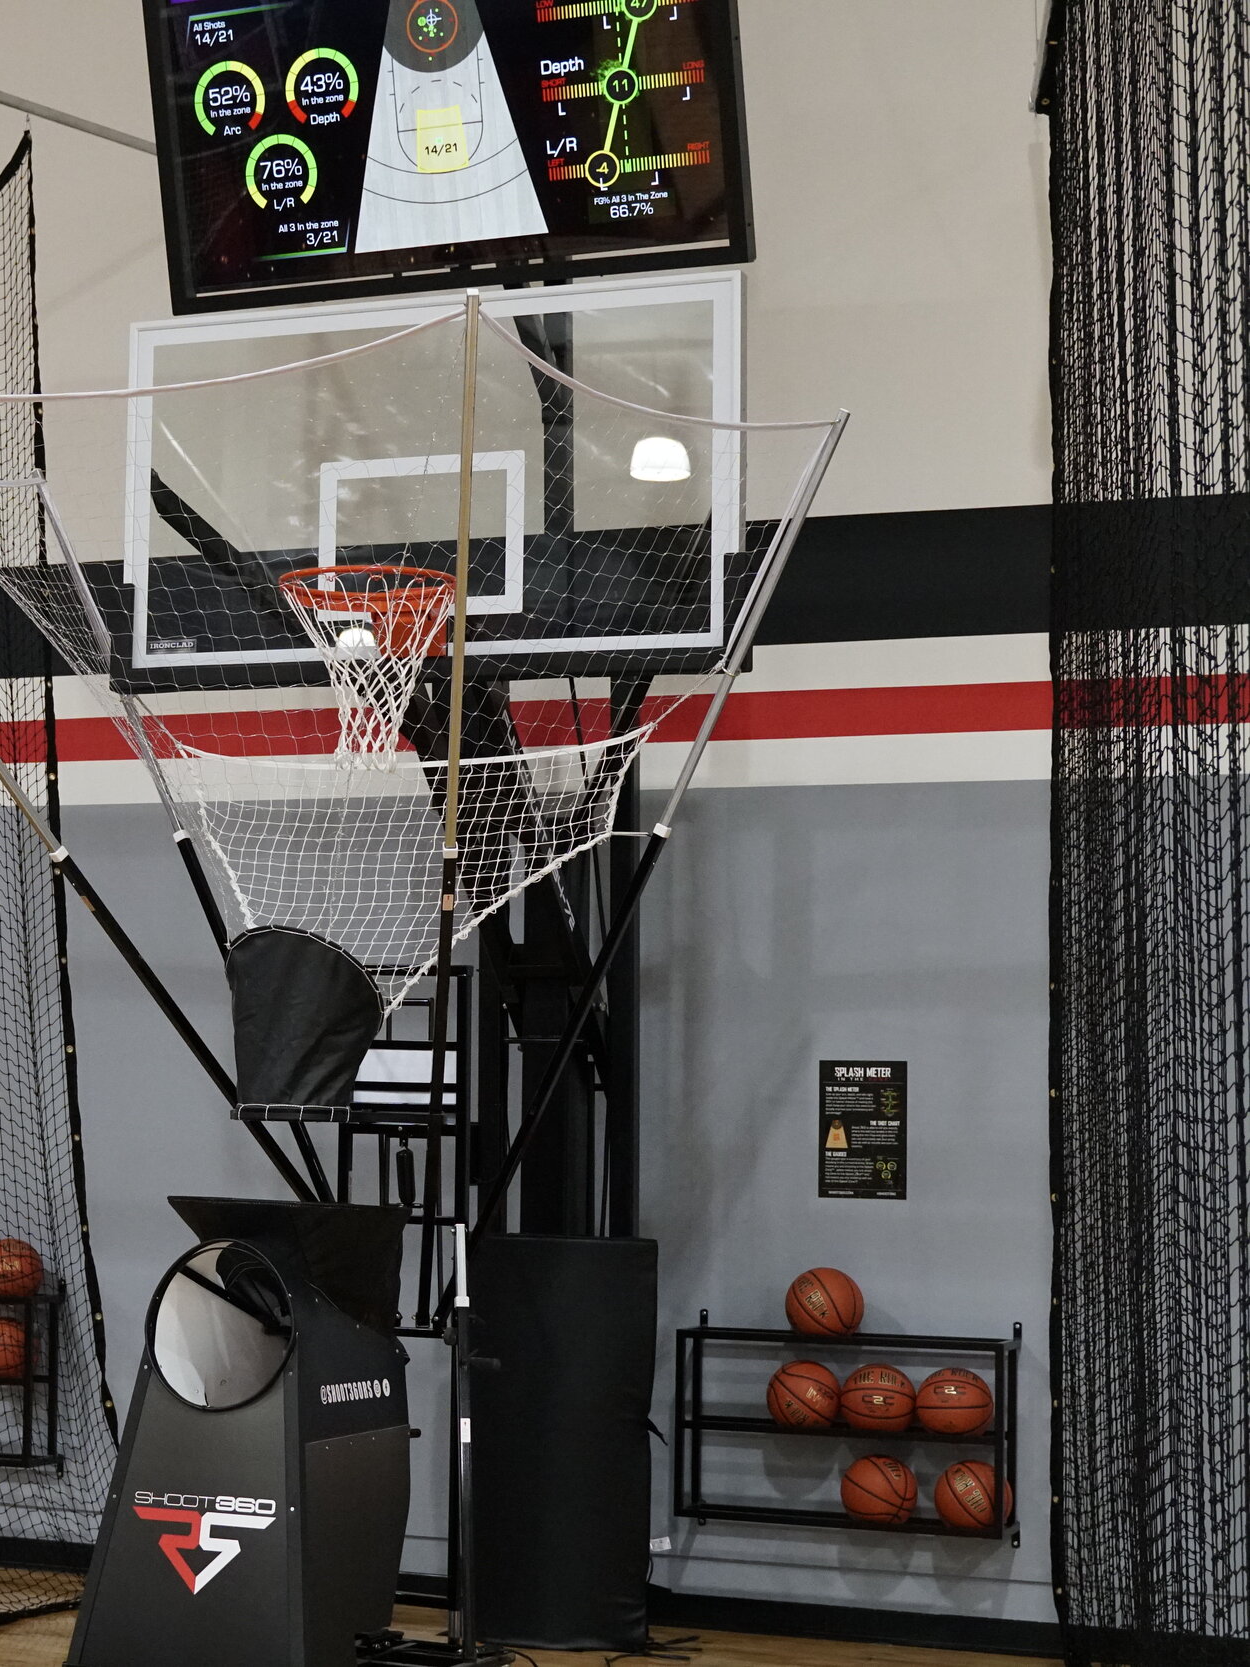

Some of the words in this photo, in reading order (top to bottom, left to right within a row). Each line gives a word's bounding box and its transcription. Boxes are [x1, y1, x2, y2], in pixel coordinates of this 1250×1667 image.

[193, 22, 202, 31] All
[204, 21, 225, 31] Shots
[195, 30, 233, 47] 14/21
[540, 56, 584, 76] Depth
[682, 60, 705, 70] LONG
[300, 72, 344, 92] 43%
[541, 77, 567, 88] SHORT
[612, 79, 628, 92] 11
[209, 85, 250, 106] 52%
[302, 97, 309, 106] In
[310, 96, 323, 105] the
[325, 94, 344, 103] zone
[210, 110, 218, 118] In
[219, 109, 231, 117] the
[233, 107, 250, 115] zone
[310, 112, 340, 125] Depth
[224, 126, 241, 136] Arc
[424, 142, 458, 156] 14/21
[546, 137, 577, 157] L/R
[260, 158, 302, 180] 76%
[548, 158, 565, 167] LEFT
[262, 183, 269, 191] In
[271, 182, 283, 190] the
[285, 180, 303, 188] zone
[650, 191, 668, 199] Zone
[274, 198, 294, 211] L/R
[610, 202, 654, 218] 66.7%
[278, 225, 288, 233] All
[289, 224, 295, 232] 3
[297, 223, 305, 231] In
[307, 221, 319, 230] the
[321, 220, 338, 228] zone
[306, 230, 338, 247] 3/21
[150, 641, 194, 649] IRONCLAD
[834, 1067, 864, 1077] SPLASH
[866, 1067, 891, 1078] METER
[320, 1380, 373, 1405] @SHOOT360RS
[134, 1491, 276, 1515] SHOOT360
